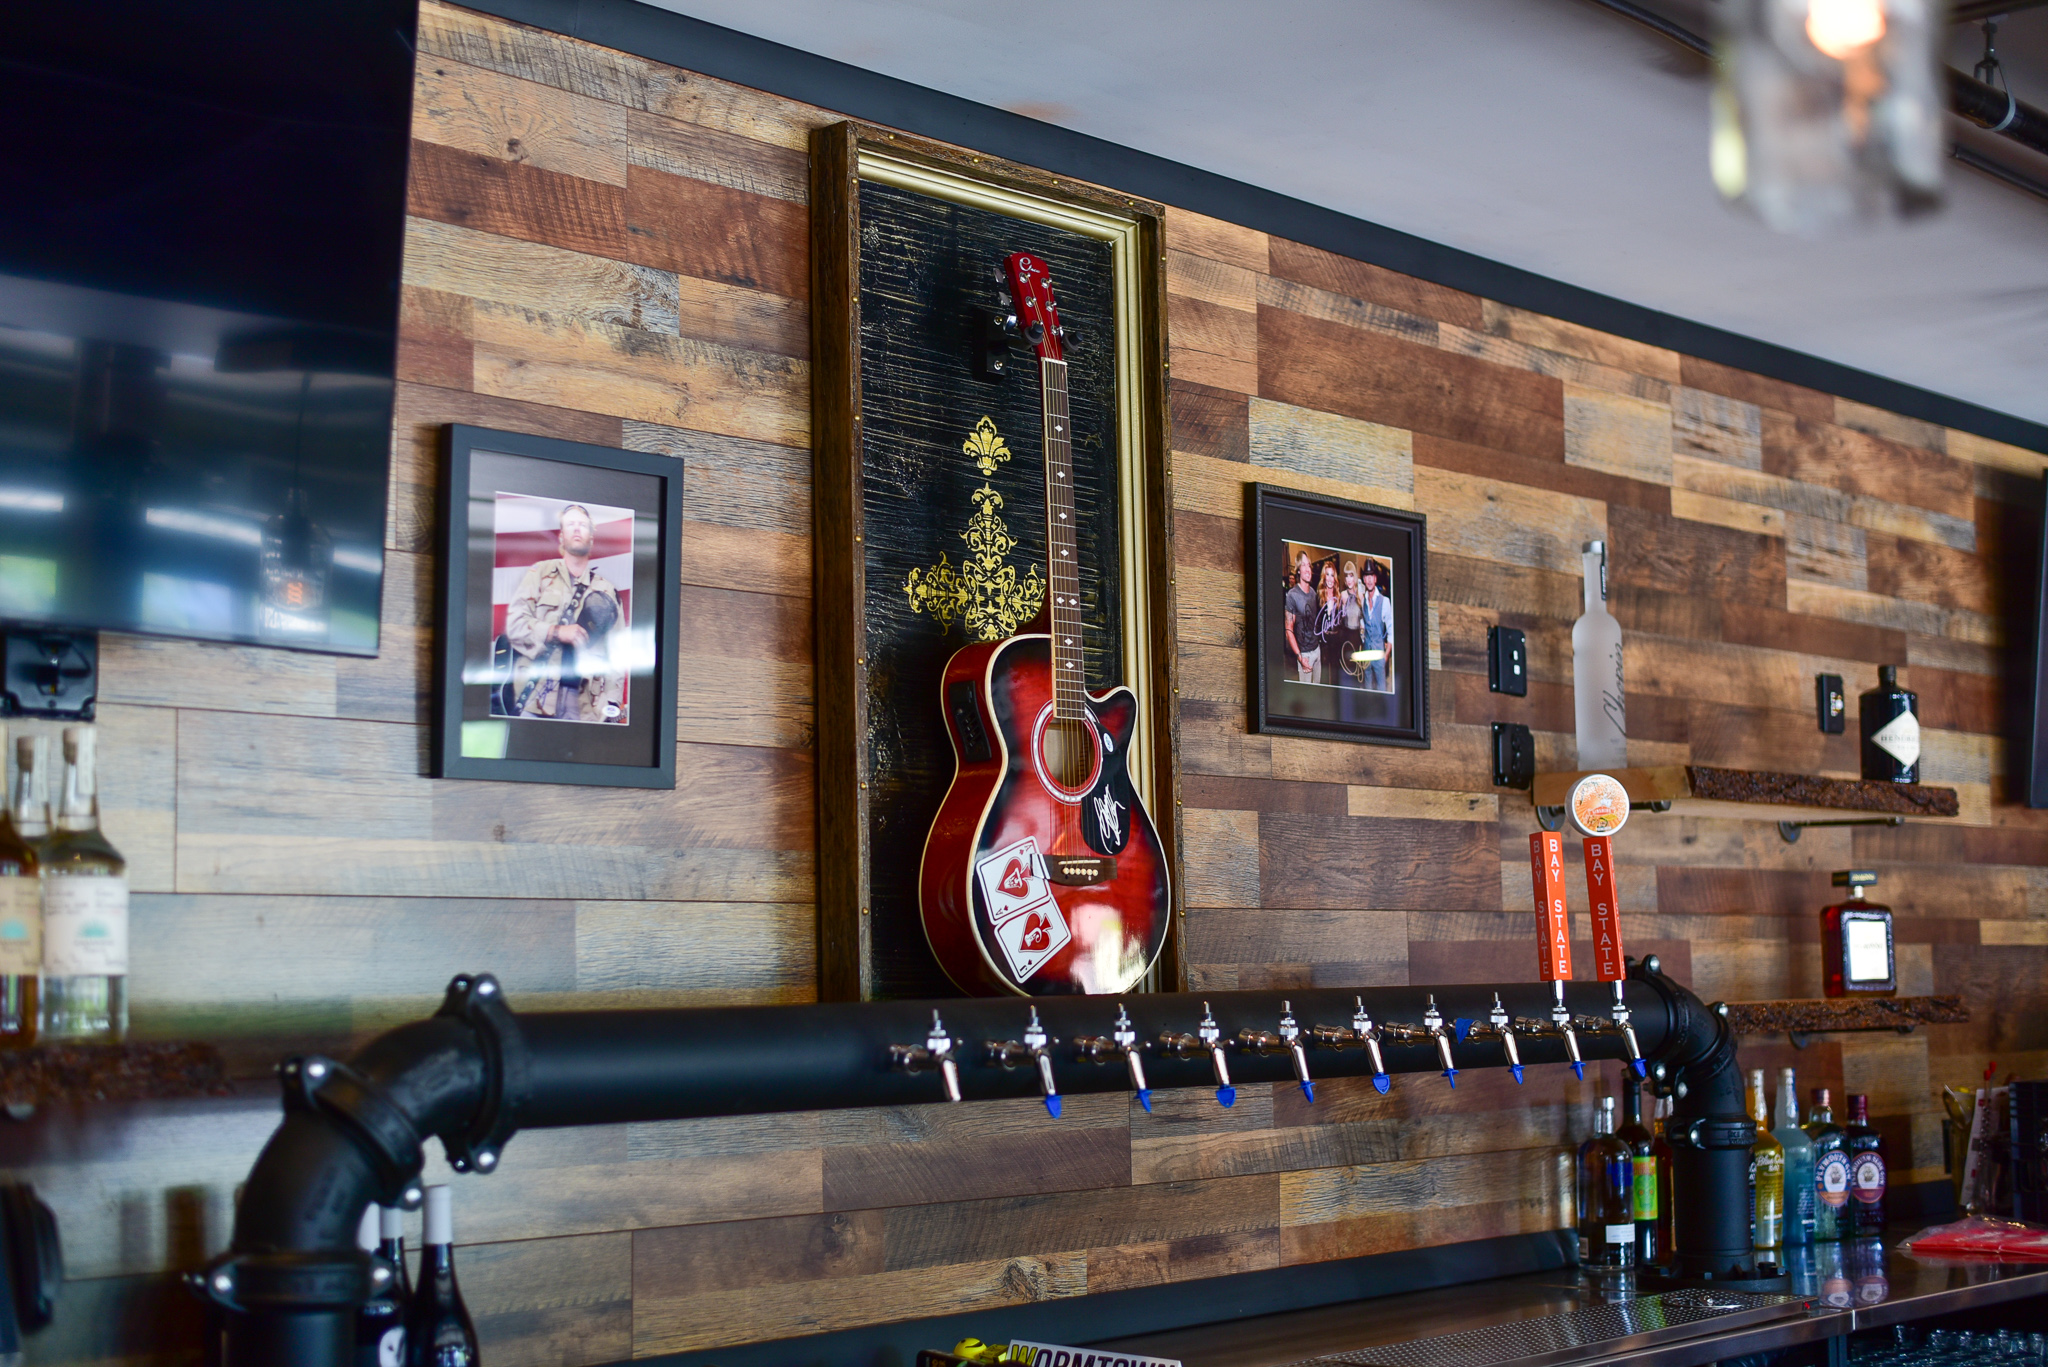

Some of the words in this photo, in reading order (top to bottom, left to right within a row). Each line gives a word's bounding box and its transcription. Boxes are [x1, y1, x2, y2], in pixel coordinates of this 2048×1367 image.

[1533, 840, 1542, 883] BAY
[1549, 838, 1560, 882] BAY
[1537, 900, 1549, 975] STATE
[1554, 899, 1567, 974] STATE
[1590, 843, 1604, 886] BAY
[1597, 902, 1614, 975] STATE
[1011, 1344, 1176, 1367] WORM
